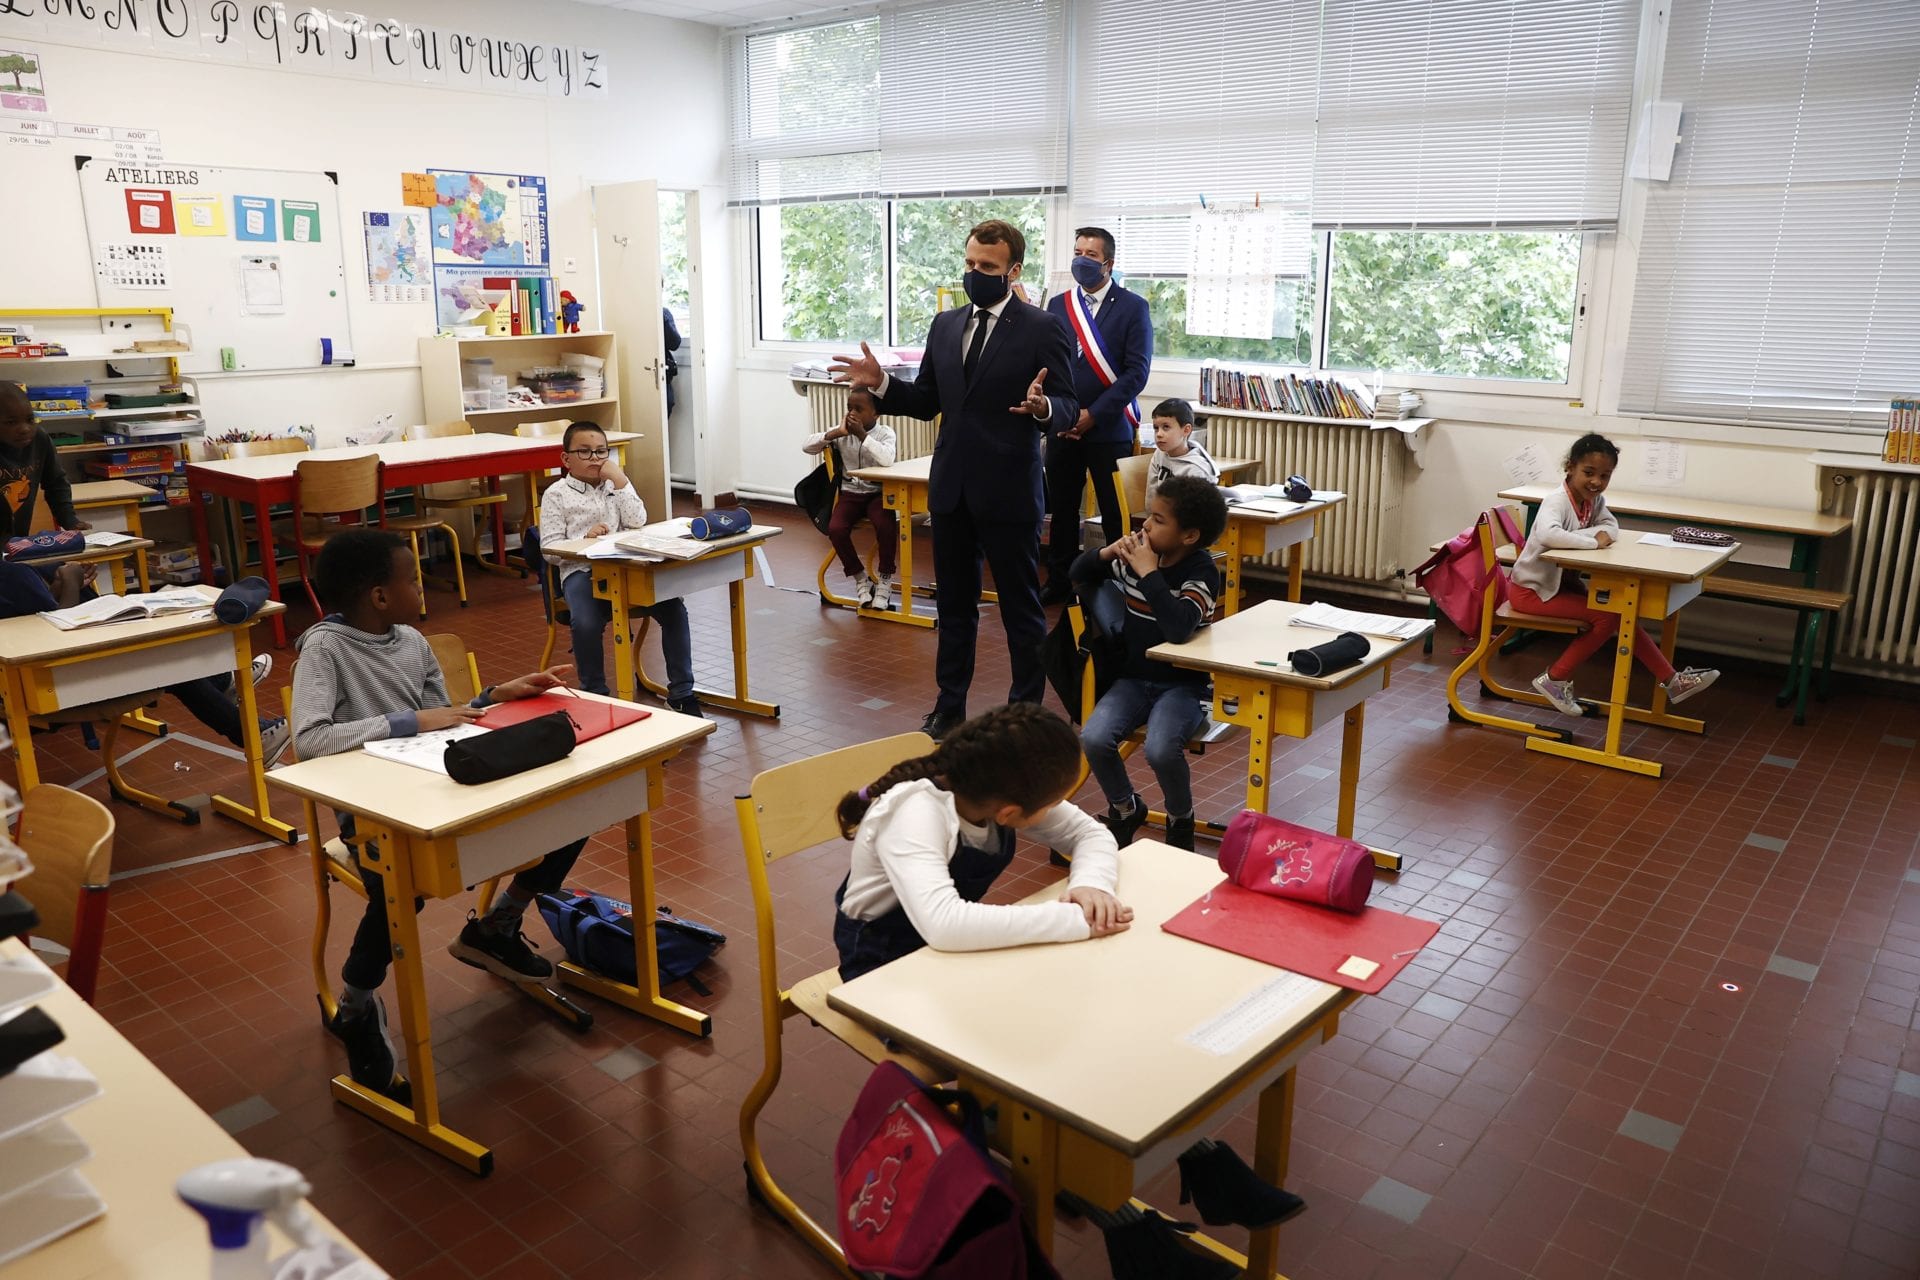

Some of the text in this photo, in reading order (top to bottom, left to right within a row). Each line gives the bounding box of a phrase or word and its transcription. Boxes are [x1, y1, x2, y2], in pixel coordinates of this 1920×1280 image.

[210, 0, 239, 43] P
[294, 12, 325, 54] R
[413, 28, 441, 70] U
[450, 33, 476, 74] V
[480, 37, 512, 78] W
[583, 51, 602, 88] Z
[20, 122, 38, 131] JUIN
[73, 126, 100, 135] JUILLET
[127, 131, 146, 140] AOÛT
[105, 168, 199, 185] ATELIERS
[538, 192, 547, 250] La France
